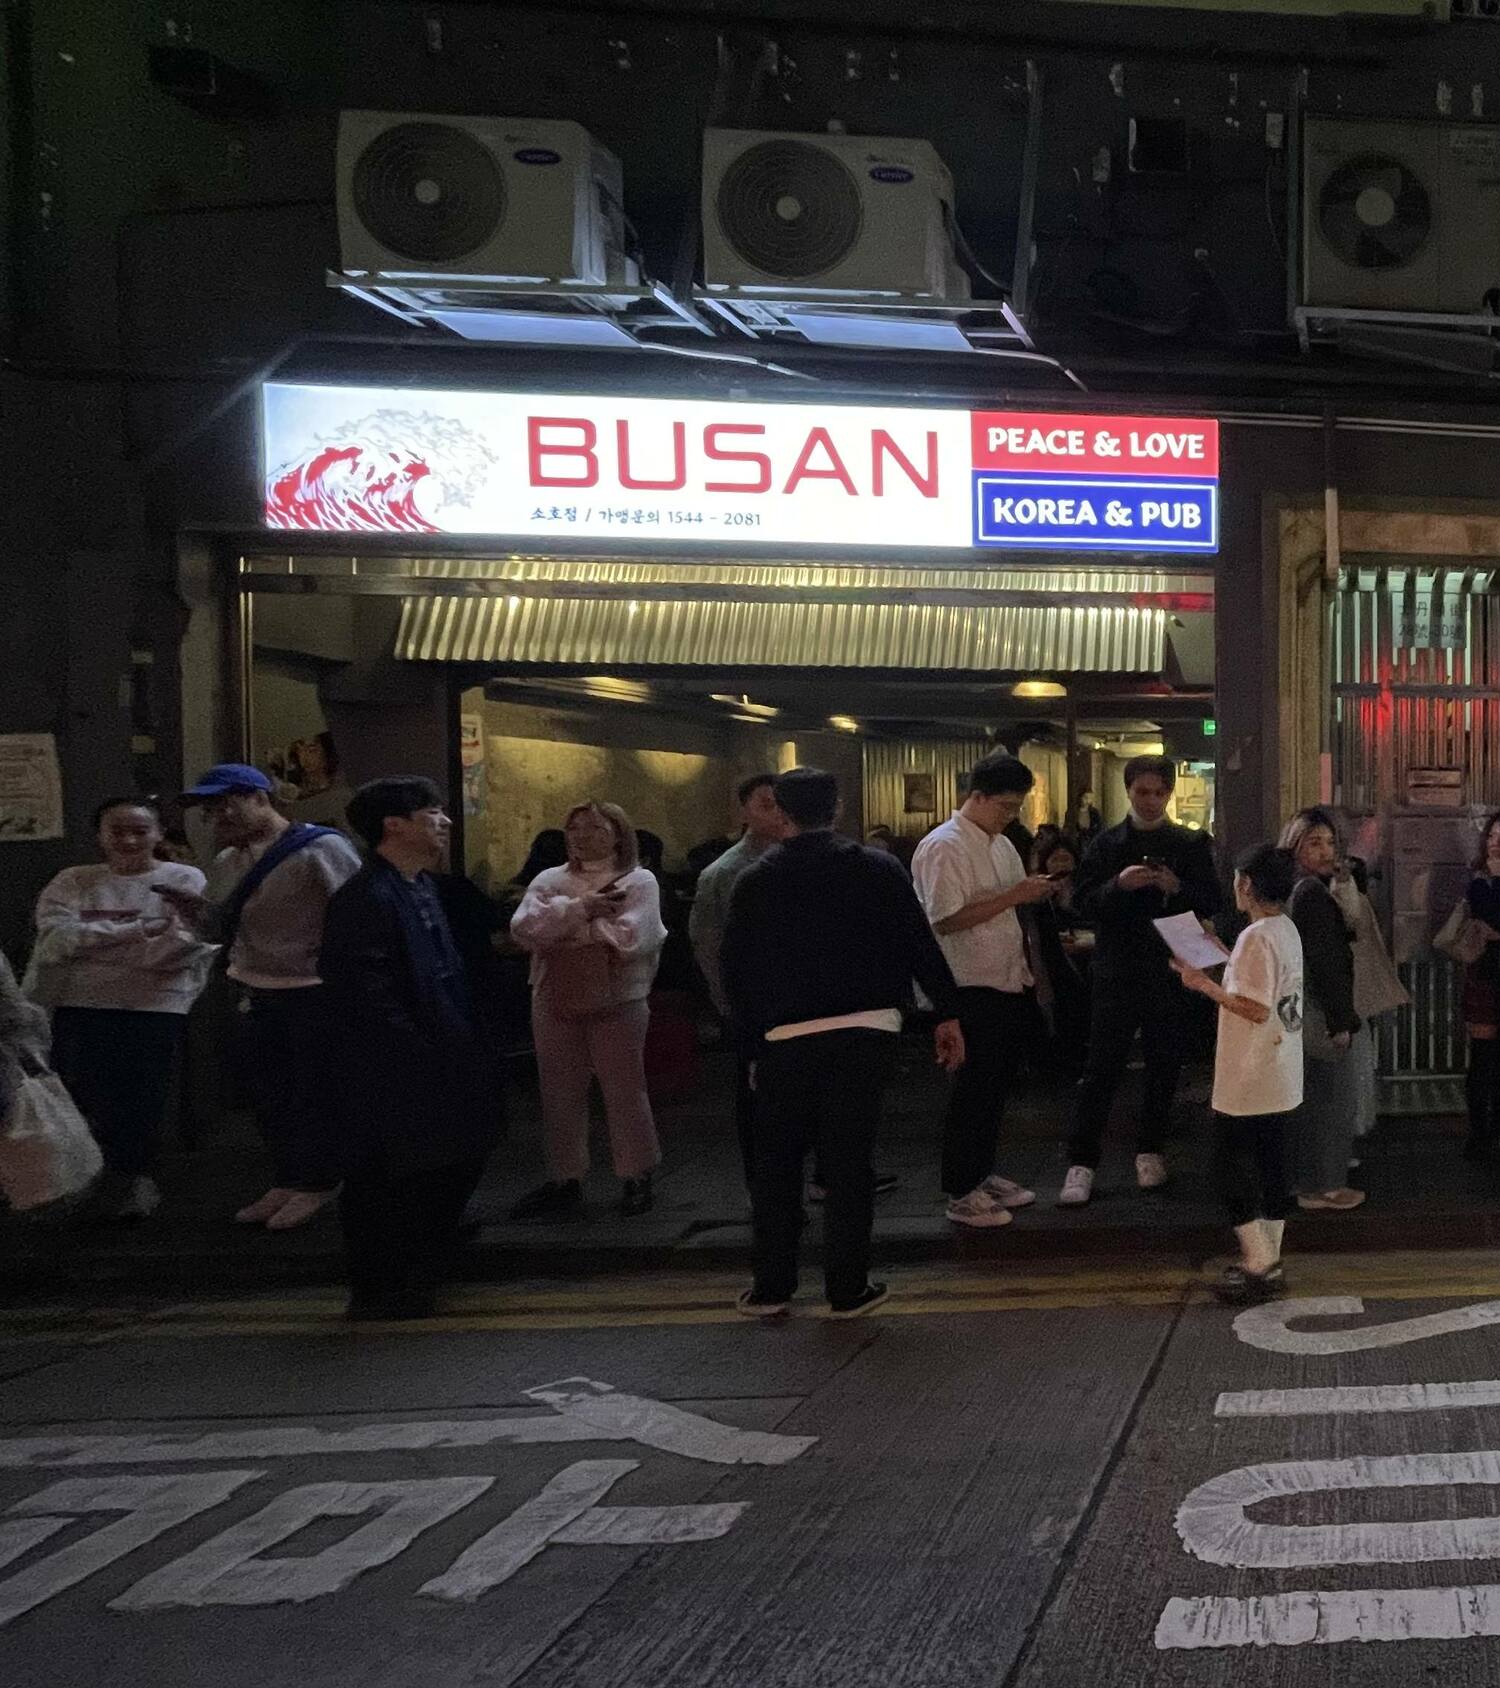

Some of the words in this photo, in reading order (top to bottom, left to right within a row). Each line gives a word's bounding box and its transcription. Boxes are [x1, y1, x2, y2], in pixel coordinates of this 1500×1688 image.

[528, 416, 939, 498] BUSAN
[988, 427, 1086, 455] PEACE
[1093, 431, 1121, 457] &
[1129, 432, 1205, 459] LOVE
[668, 511, 703, 524] 1544
[724, 512, 761, 526] 2081
[993, 497, 1098, 526] KOREA
[1105, 501, 1133, 527] &
[1141, 502, 1202, 528] PUB
